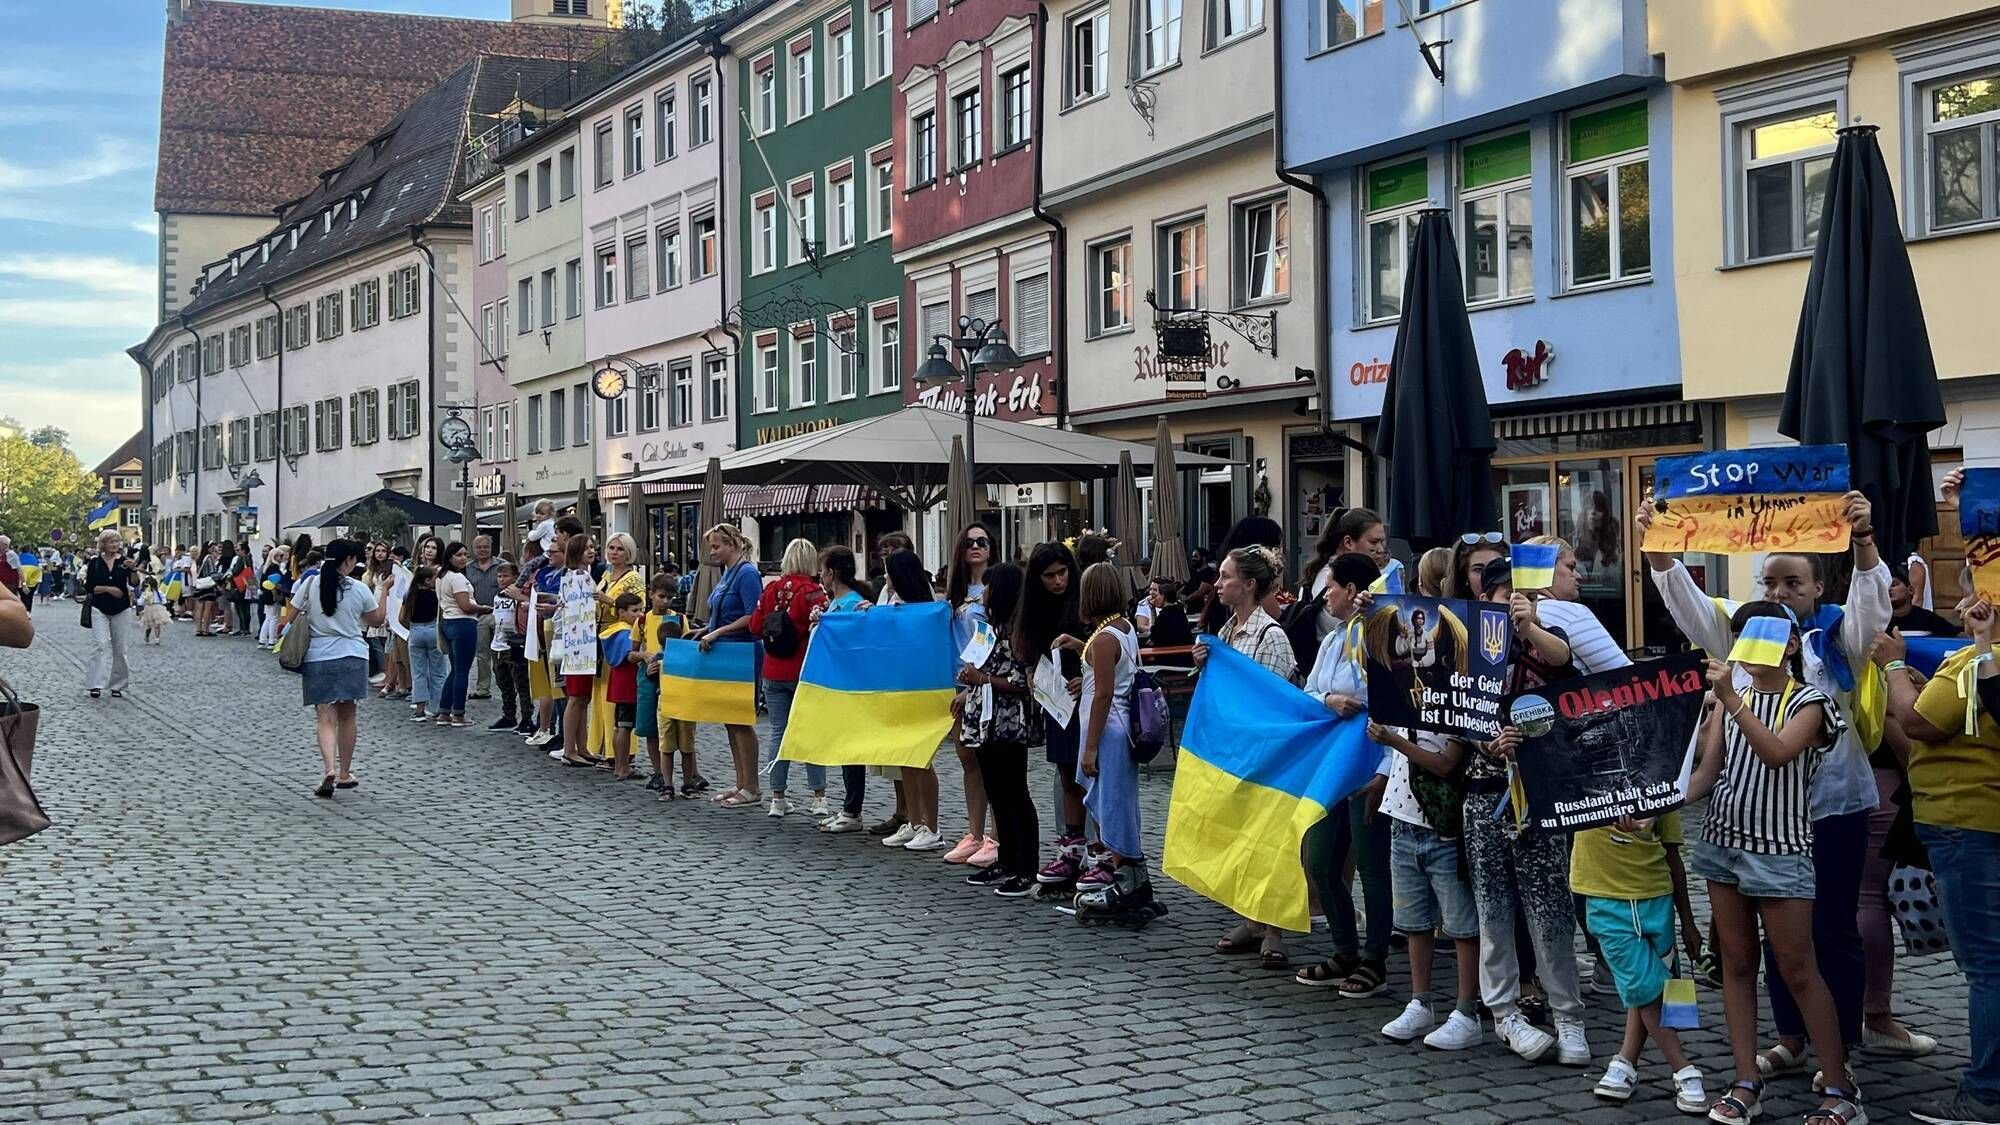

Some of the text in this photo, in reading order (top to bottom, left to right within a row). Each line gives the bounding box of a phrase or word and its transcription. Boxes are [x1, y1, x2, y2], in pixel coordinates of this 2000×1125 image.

[1685, 462, 1759, 494] Stop
[1450, 671, 1503, 696] der Geist
[1558, 669, 1703, 720] Olenivka
[1421, 706, 1440, 724] ist
[1422, 687, 1500, 716] der Ukrainer
[1554, 795, 1614, 815] Russland
[1616, 788, 1642, 803] hält
[1645, 781, 1671, 797] sich
[1540, 816, 1557, 829] an
[1560, 804, 1635, 827] humanitäre
